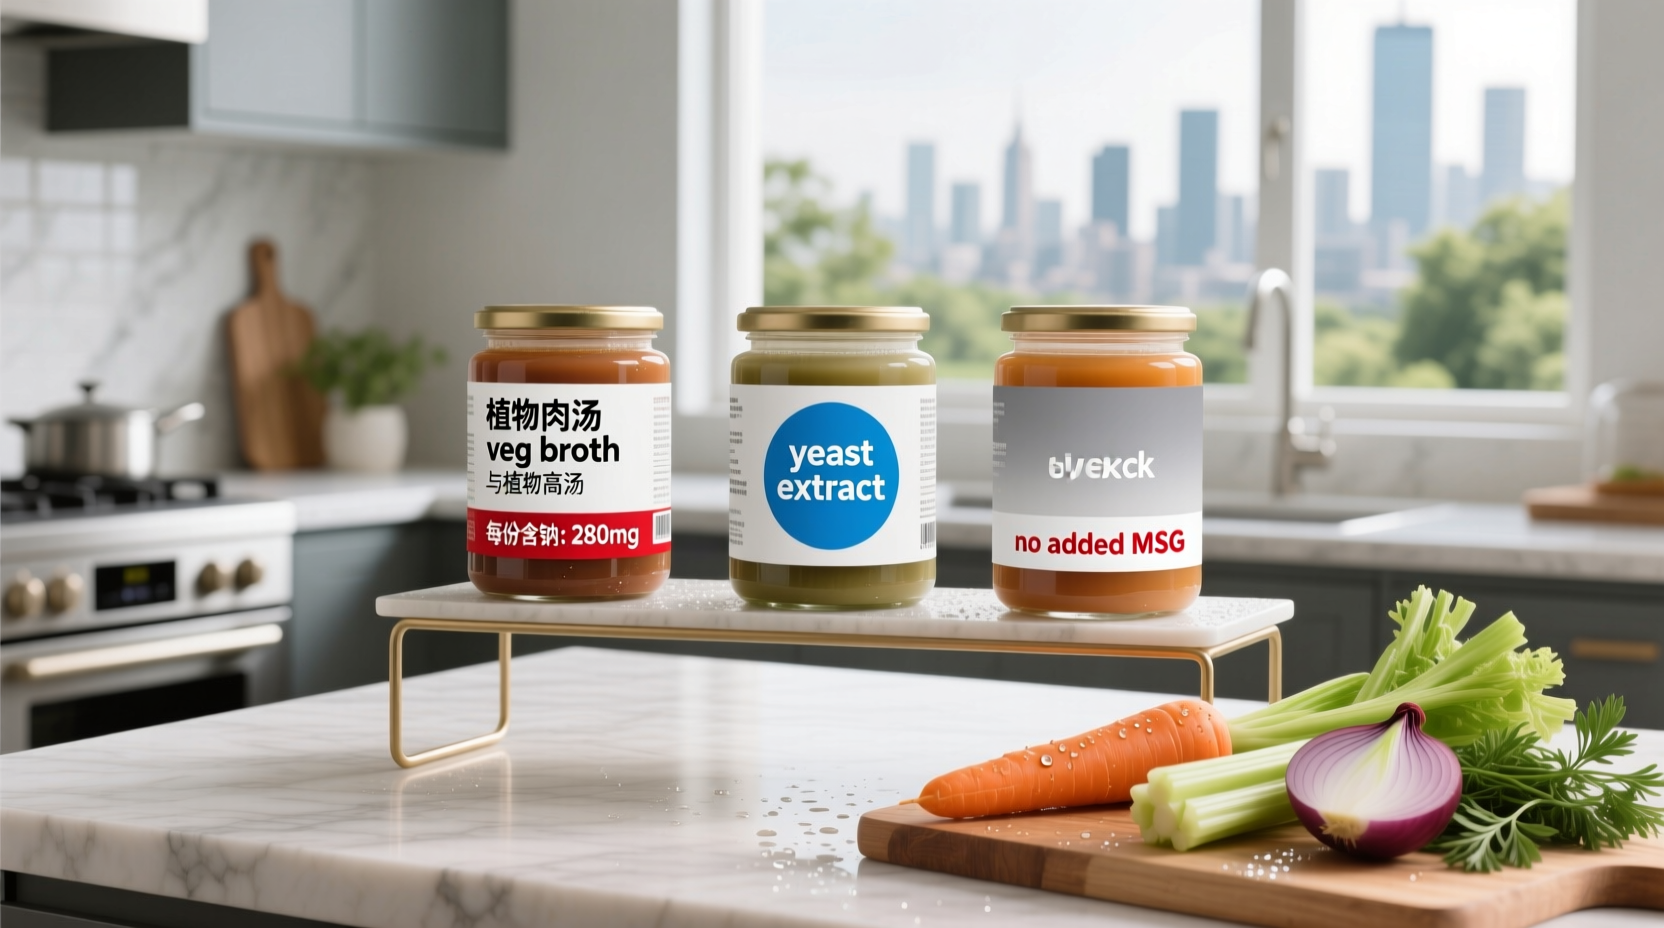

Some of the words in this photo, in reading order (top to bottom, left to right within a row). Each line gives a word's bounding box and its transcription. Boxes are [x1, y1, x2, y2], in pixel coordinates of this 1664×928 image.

[486, 397, 602, 432] 植物肉汤
[486, 441, 532, 469] veg
[540, 435, 620, 463] broth
[788, 440, 874, 473] yeast
[776, 474, 886, 502] extract
[571, 523, 640, 550] 280mg
[1015, 534, 1042, 554] no
[1047, 531, 1125, 556] added
[1131, 529, 1186, 555] MSG
